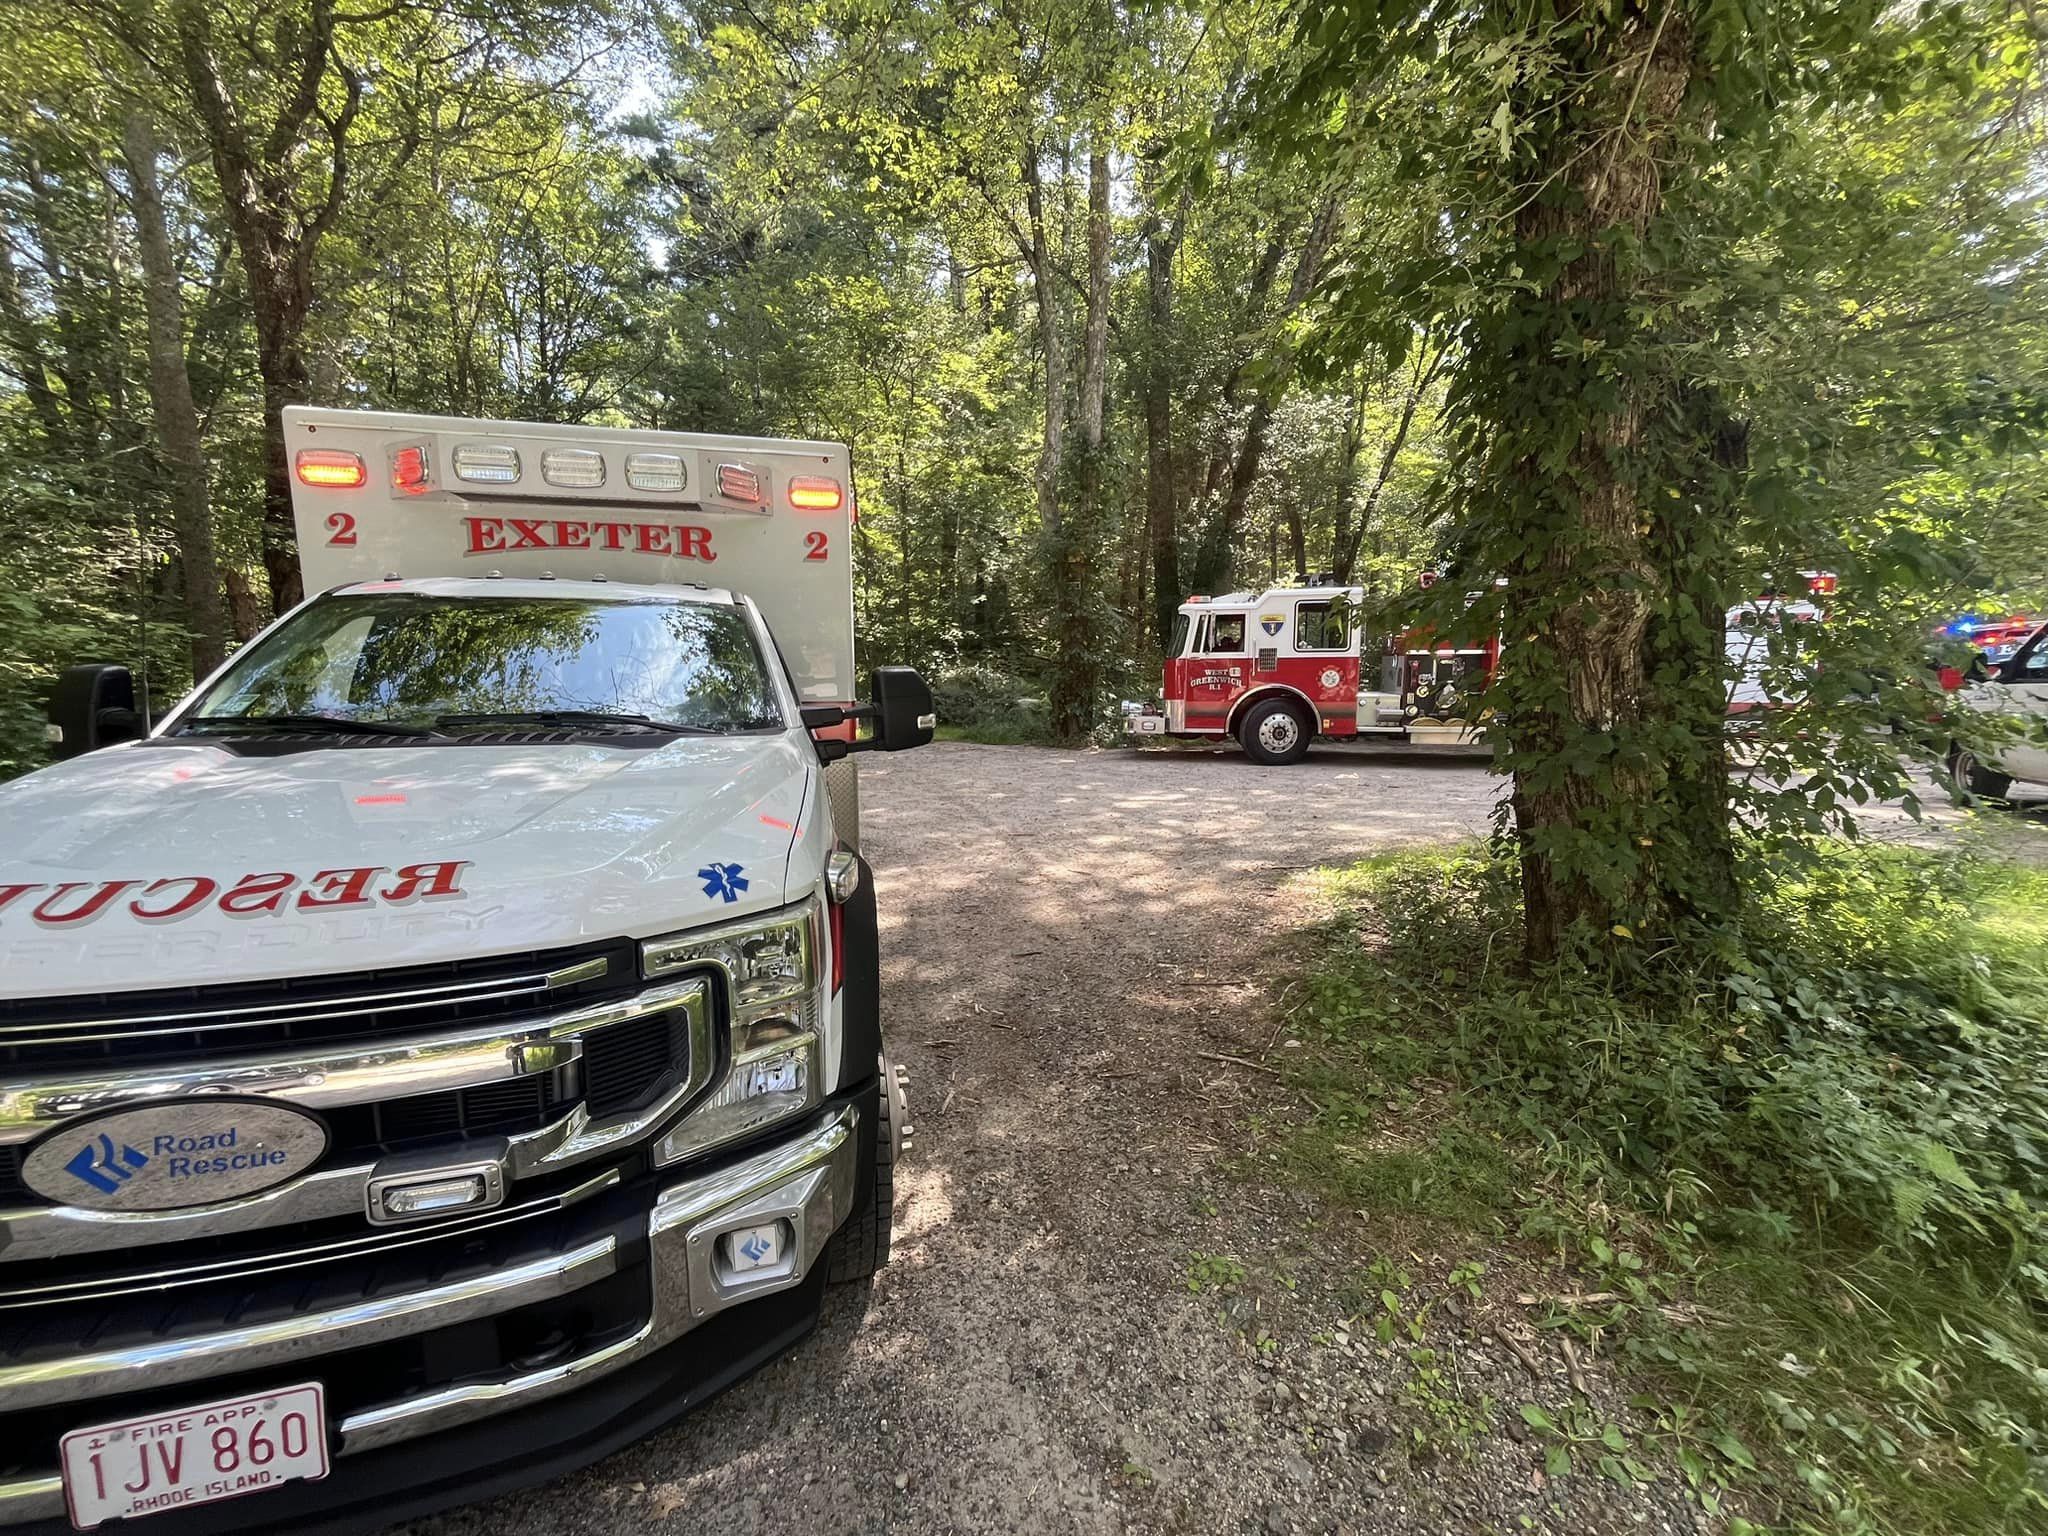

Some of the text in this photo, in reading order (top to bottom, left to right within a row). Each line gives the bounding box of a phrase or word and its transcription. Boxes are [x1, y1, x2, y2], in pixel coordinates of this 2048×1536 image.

[326, 512, 357, 546] 2
[463, 516, 717, 561] EXETER
[804, 531, 829, 562] 2
[1190, 676, 1242, 688] GREENWICH
[153, 1127, 237, 1155] Road
[169, 1149, 287, 1178] Rescue
[131, 1418, 193, 1442] FIRE
[211, 1412, 308, 1473] 860
[204, 1470, 272, 1496] ISLAND
